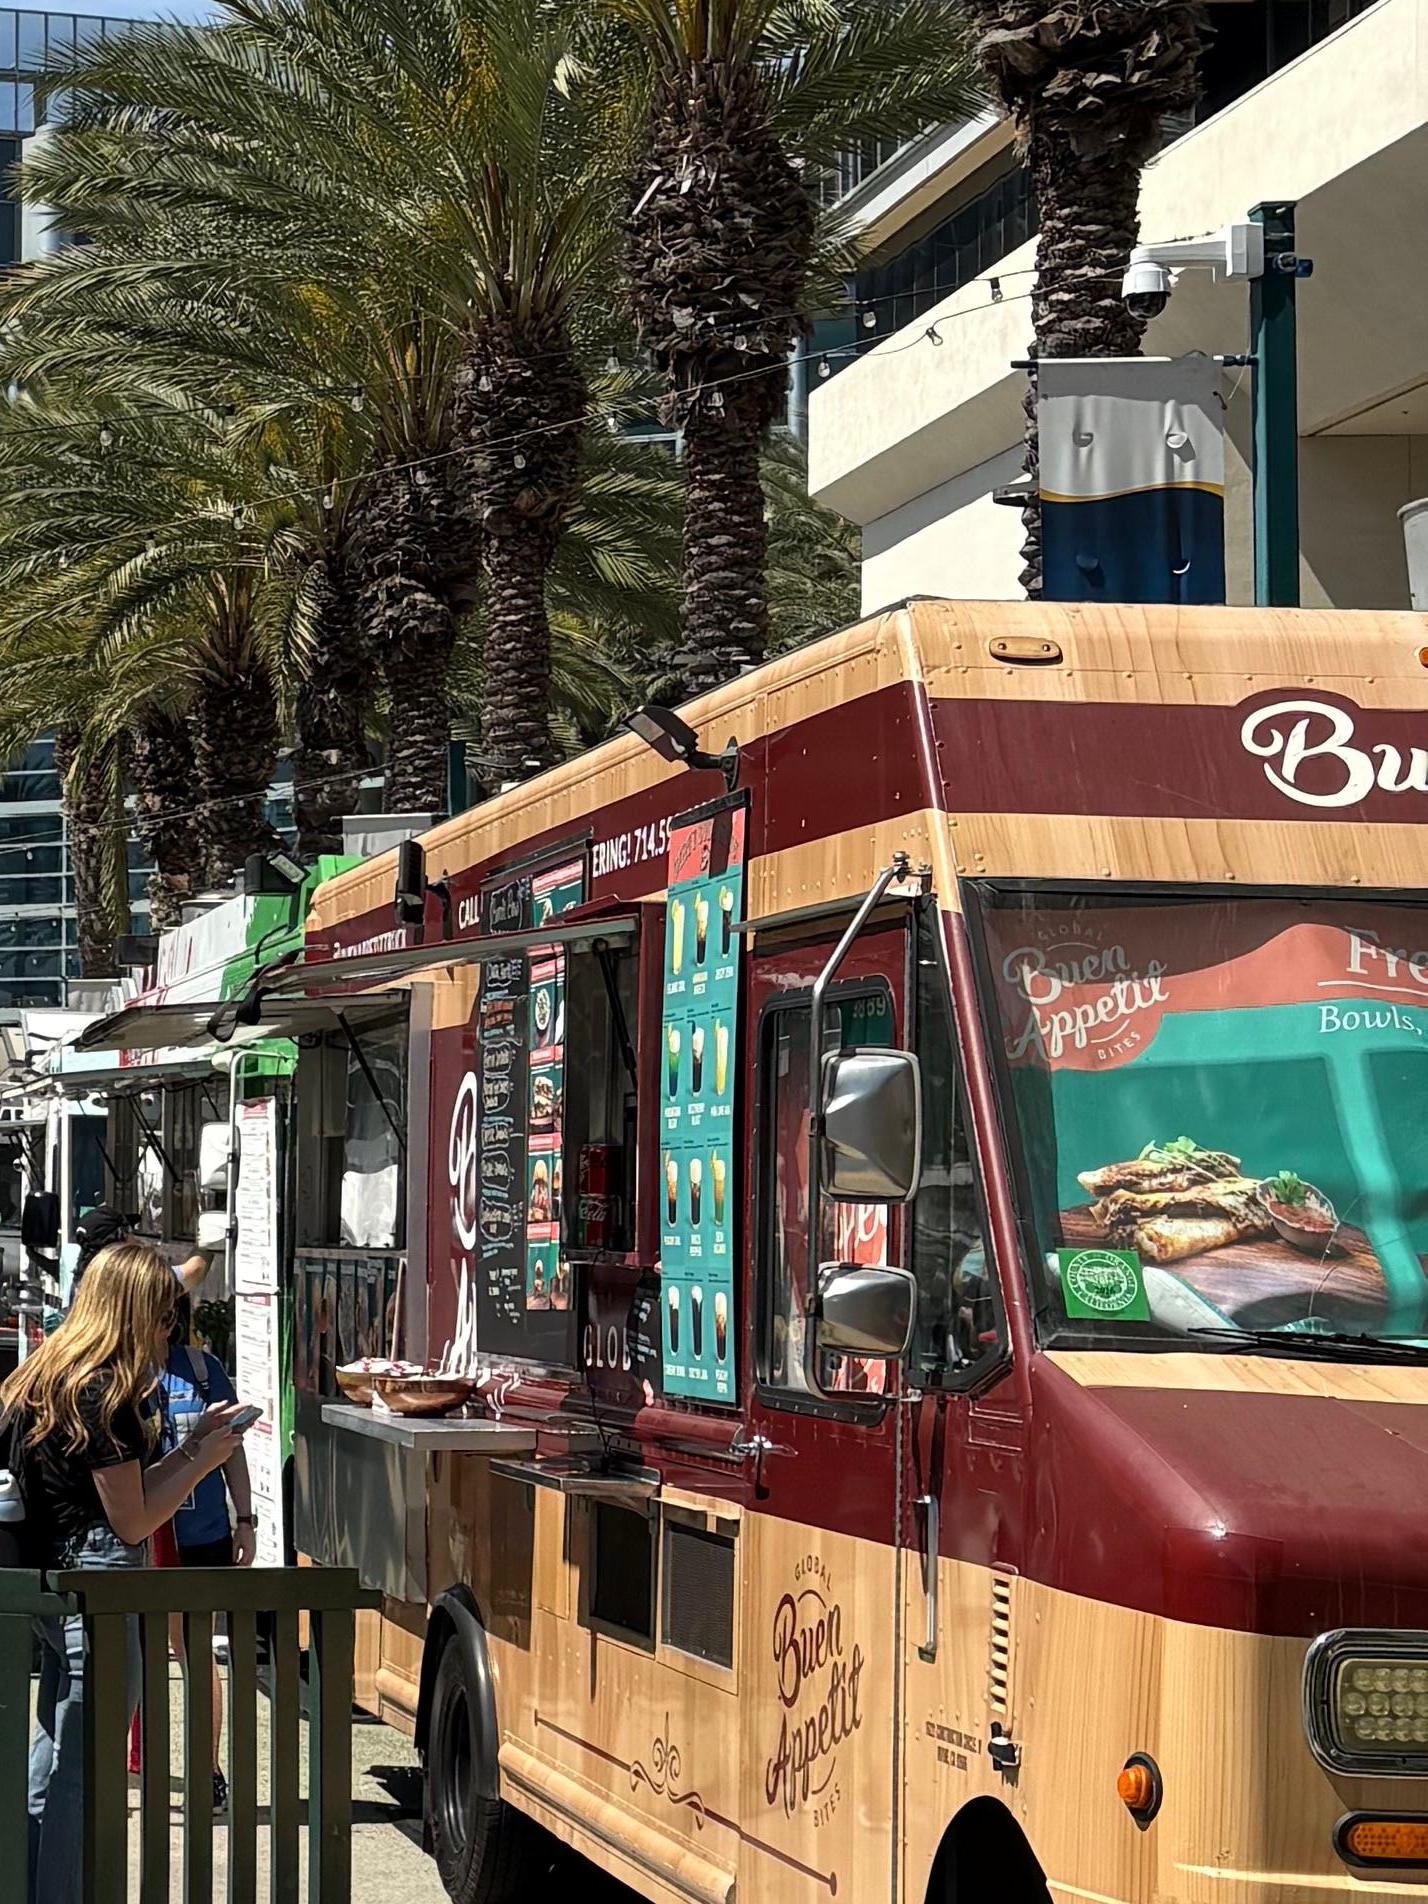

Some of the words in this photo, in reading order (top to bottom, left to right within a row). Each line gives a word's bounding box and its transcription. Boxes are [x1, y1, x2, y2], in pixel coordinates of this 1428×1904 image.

[458, 895, 480, 930] CALL
[1002, 945, 1130, 1004] Buen
[1004, 958, 1170, 1059] Appetit
[1097, 1030, 1142, 1061] BITES
[794, 1554, 832, 1593] GLOBAL
[773, 1592, 844, 1709] Buen
[765, 1643, 865, 1820] Appetit
[813, 1782, 842, 1829] BITES
